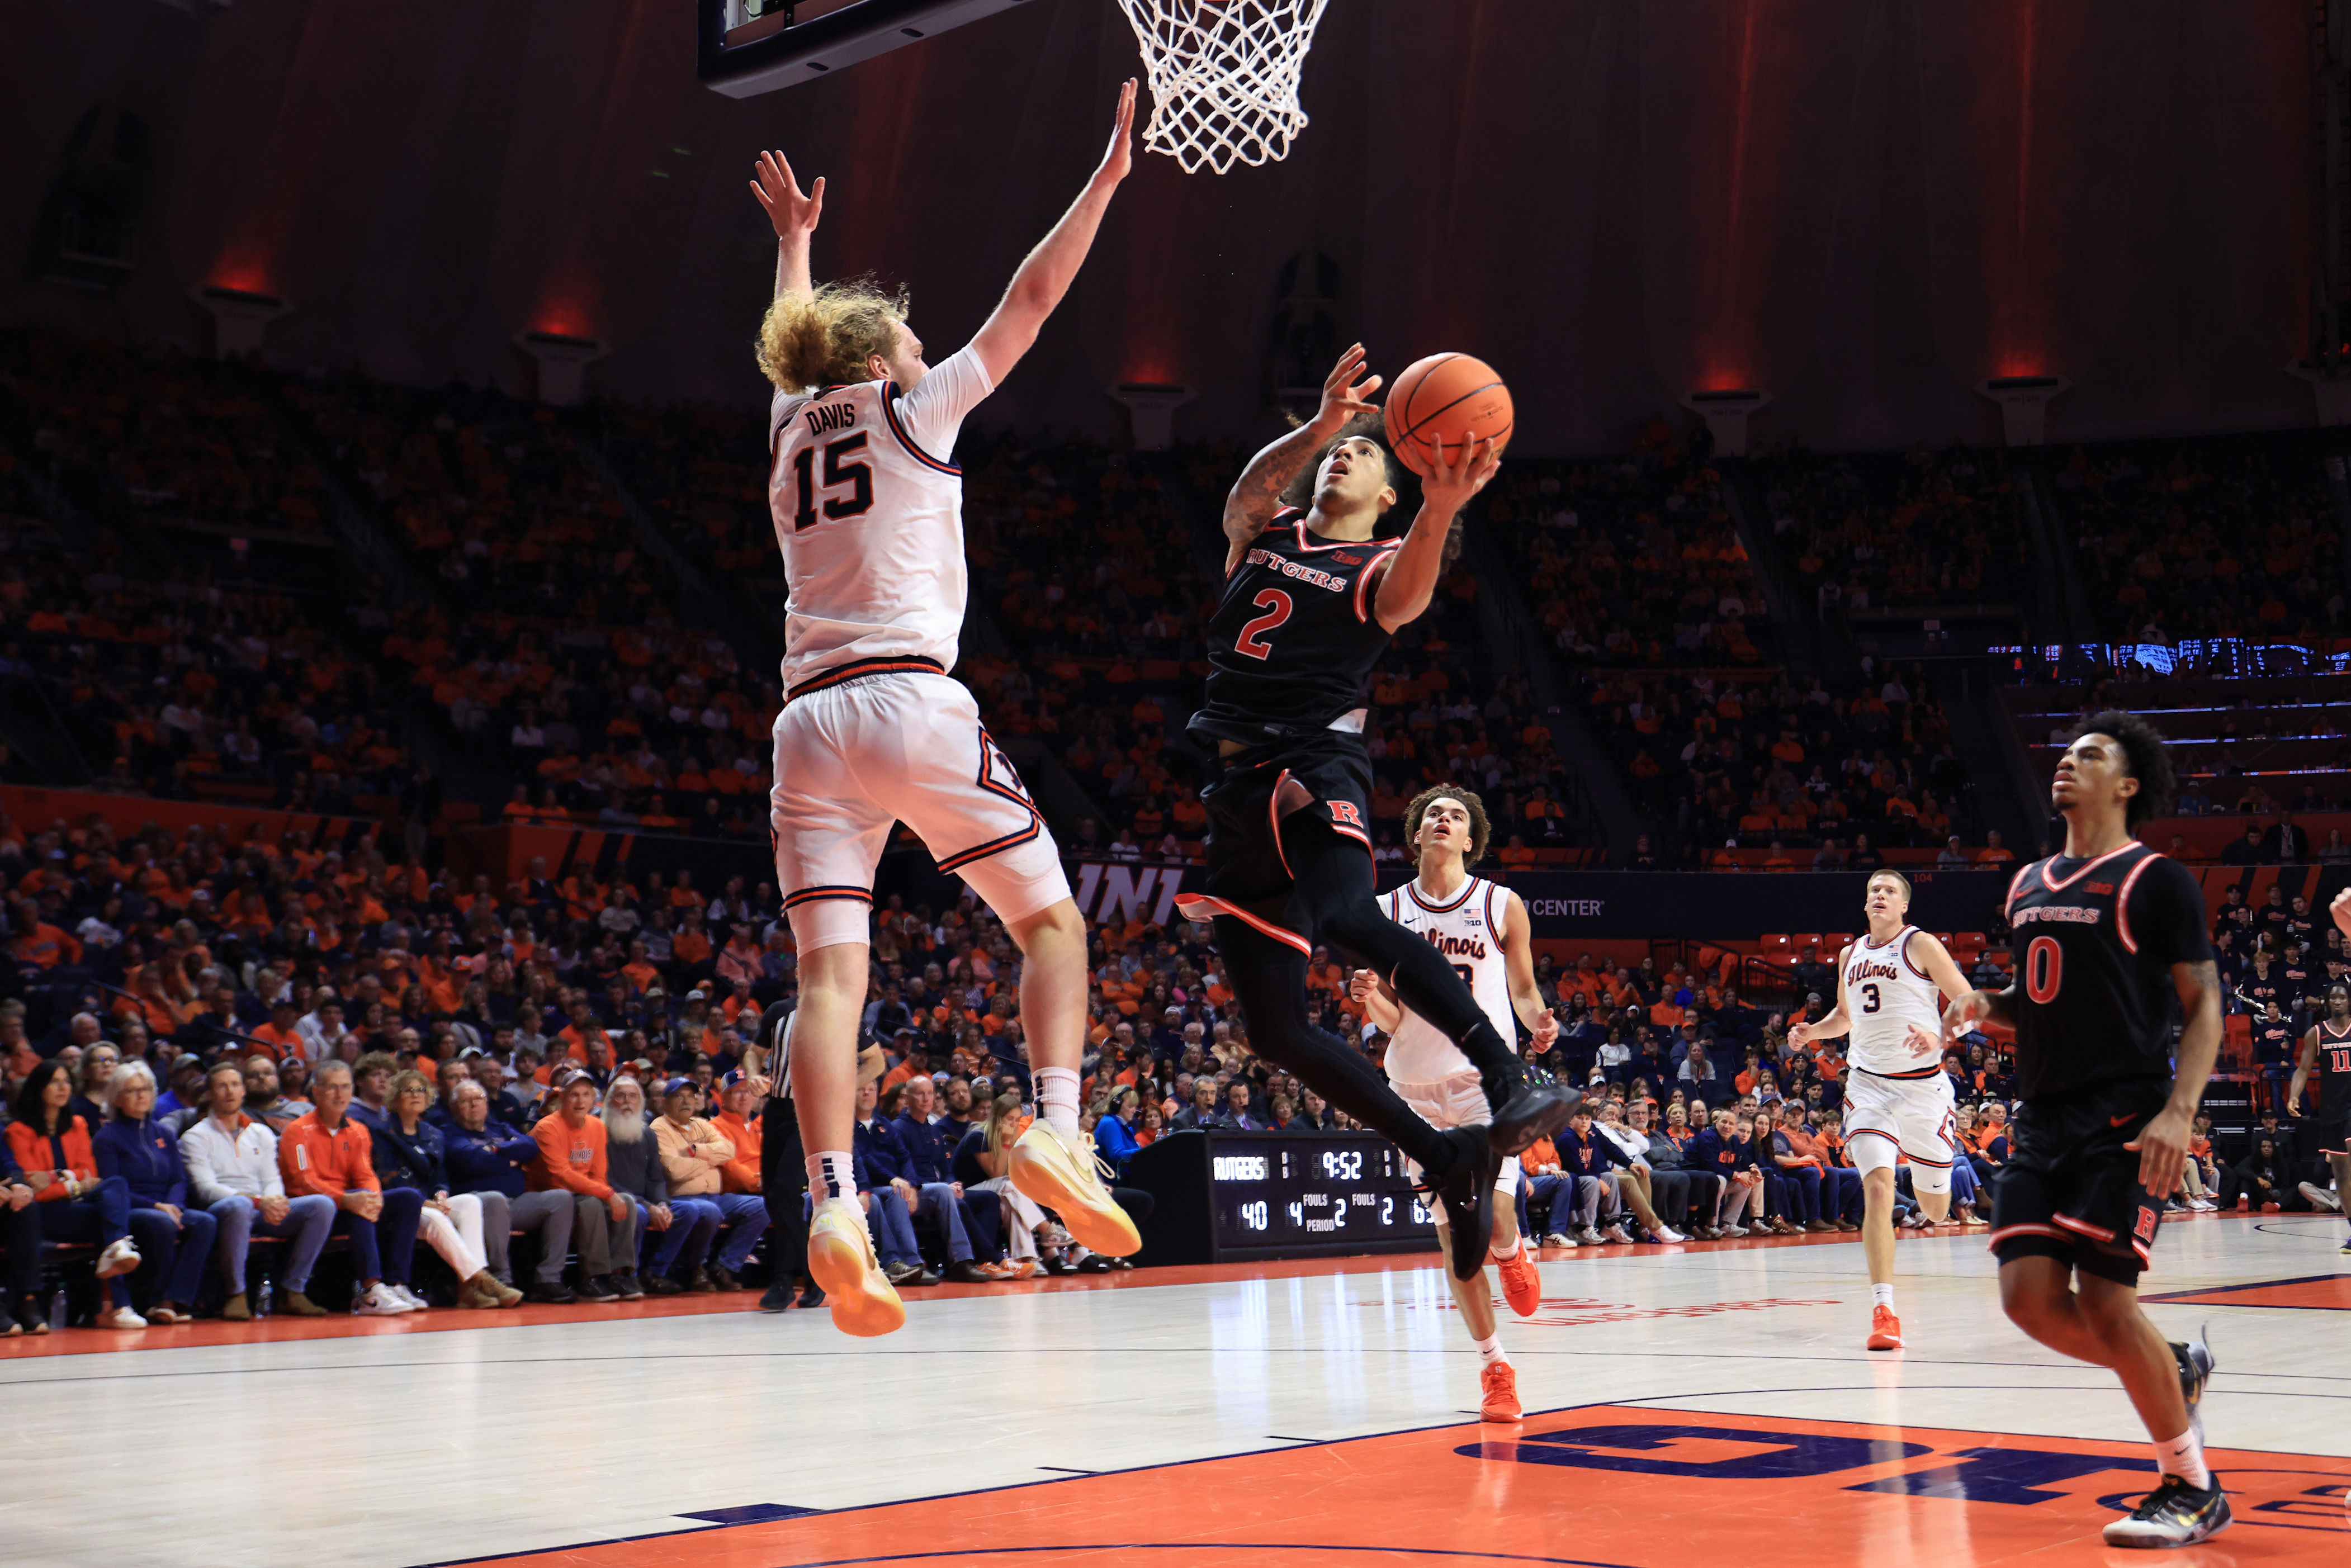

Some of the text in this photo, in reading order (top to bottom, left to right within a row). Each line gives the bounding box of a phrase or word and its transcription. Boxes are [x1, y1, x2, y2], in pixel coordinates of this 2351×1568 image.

[805, 404, 855, 436] DAVIS
[793, 430, 874, 532] 15
[1246, 548, 1347, 593] RUTGERS
[1234, 588, 1293, 661] 2
[1326, 800, 1364, 829] R
[1914, 873, 1932, 883] 104
[1532, 900, 1601, 916] CENTER
[2013, 906, 2101, 929] RUTGERS
[1848, 959, 1897, 987] Illinois
[2026, 936, 2063, 1005] 0
[1862, 983, 1880, 1013] 3
[2331, 1050, 2351, 1073] 11
[1213, 1156, 1265, 1181] RUTGERS
[1281, 1151, 1288, 1164] B
[1322, 1151, 1363, 1180] 9:52
[1384, 1149, 1391, 1162] B
[1282, 1166, 1290, 1179] B
[1385, 1164, 1392, 1177] B
[1303, 1193, 1328, 1206] FOULS
[1351, 1193, 1376, 1206] FOULS
[1382, 1197, 1394, 1225] 2
[1242, 1200, 1268, 1230] 40
[1289, 1202, 1303, 1226] 4
[1306, 1198, 1346, 1232] PERIOD 2
[2134, 1205, 2155, 1243] R
